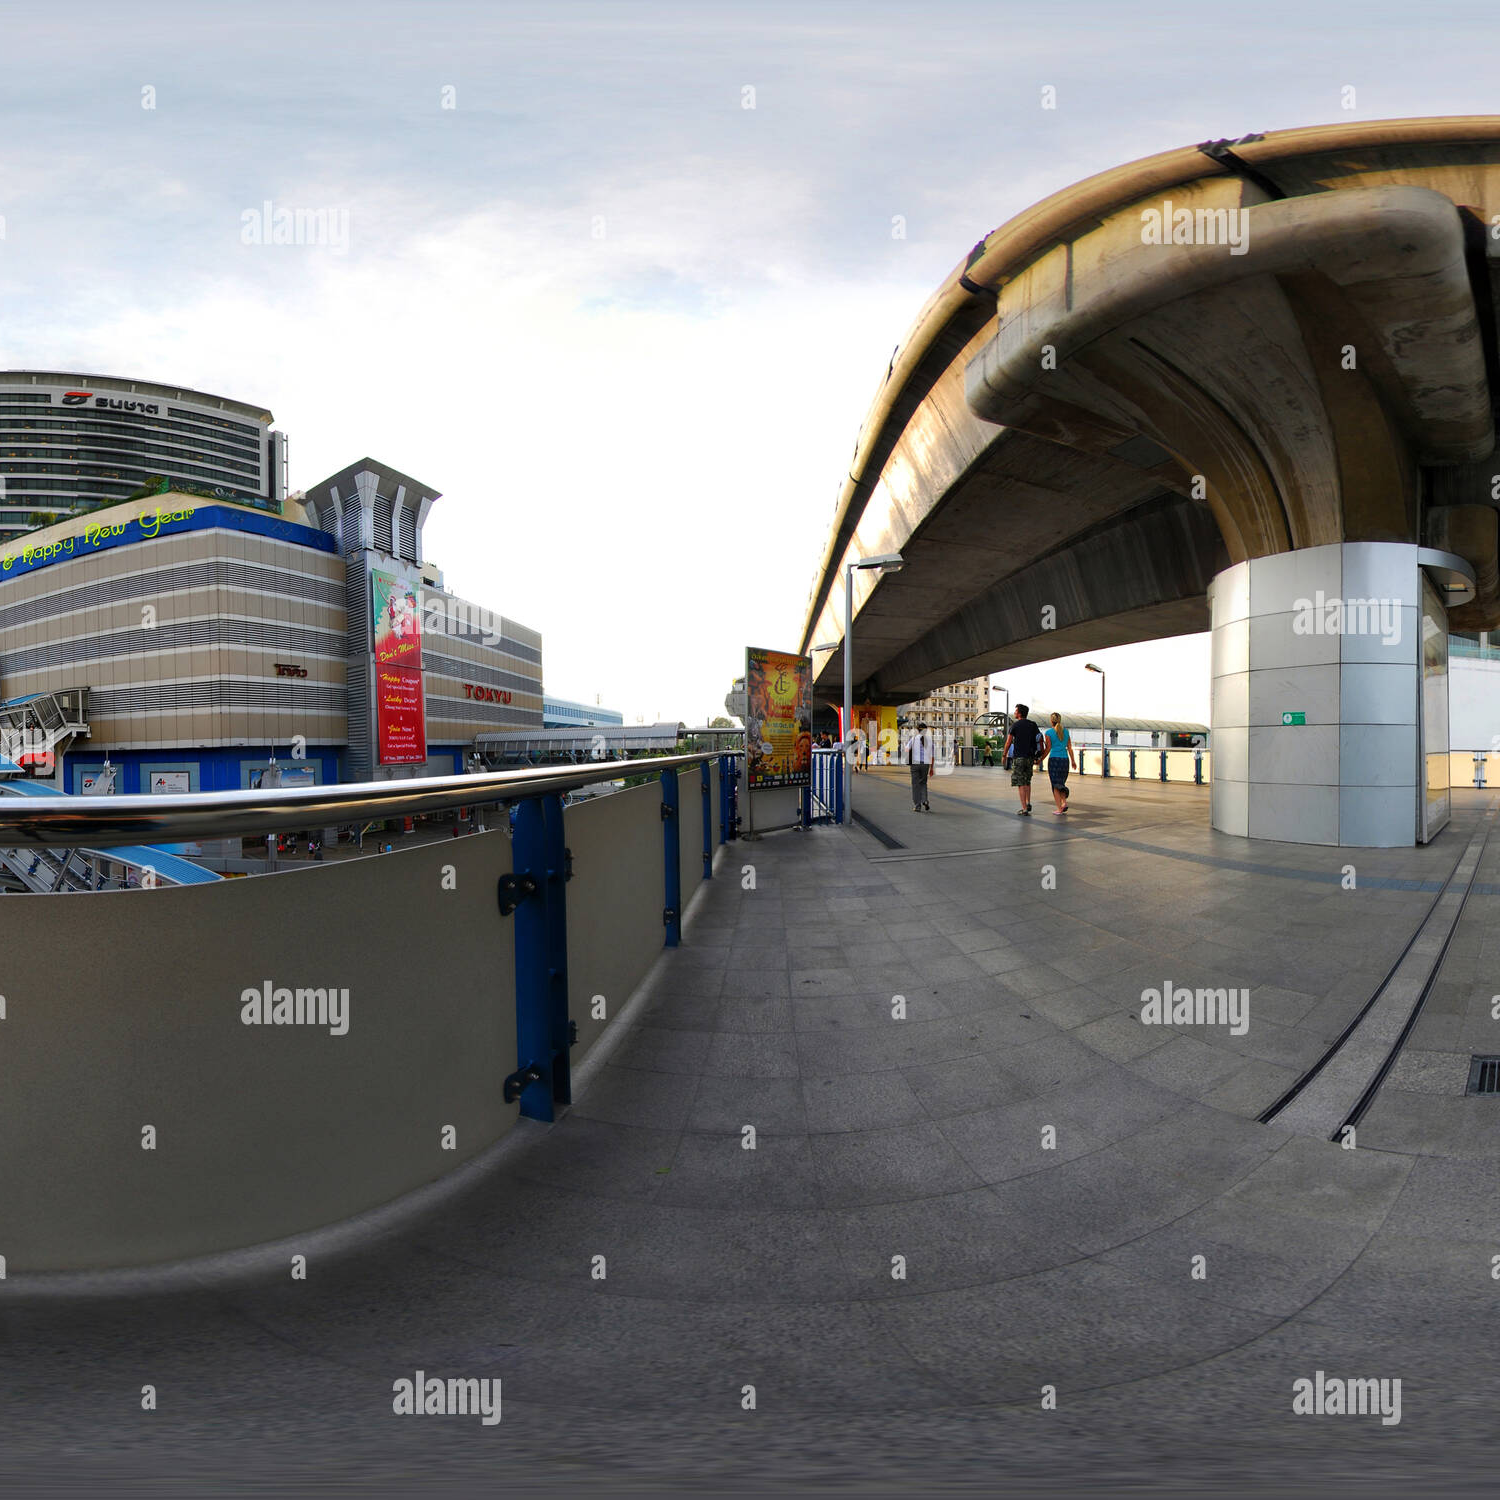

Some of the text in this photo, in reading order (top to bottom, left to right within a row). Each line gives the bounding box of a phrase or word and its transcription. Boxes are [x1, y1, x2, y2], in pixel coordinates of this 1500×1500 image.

[22, 538, 74, 566] Happy
[84, 522, 127, 546] New
[139, 507, 196, 538] Year
[463, 684, 512, 705] TOKYU
